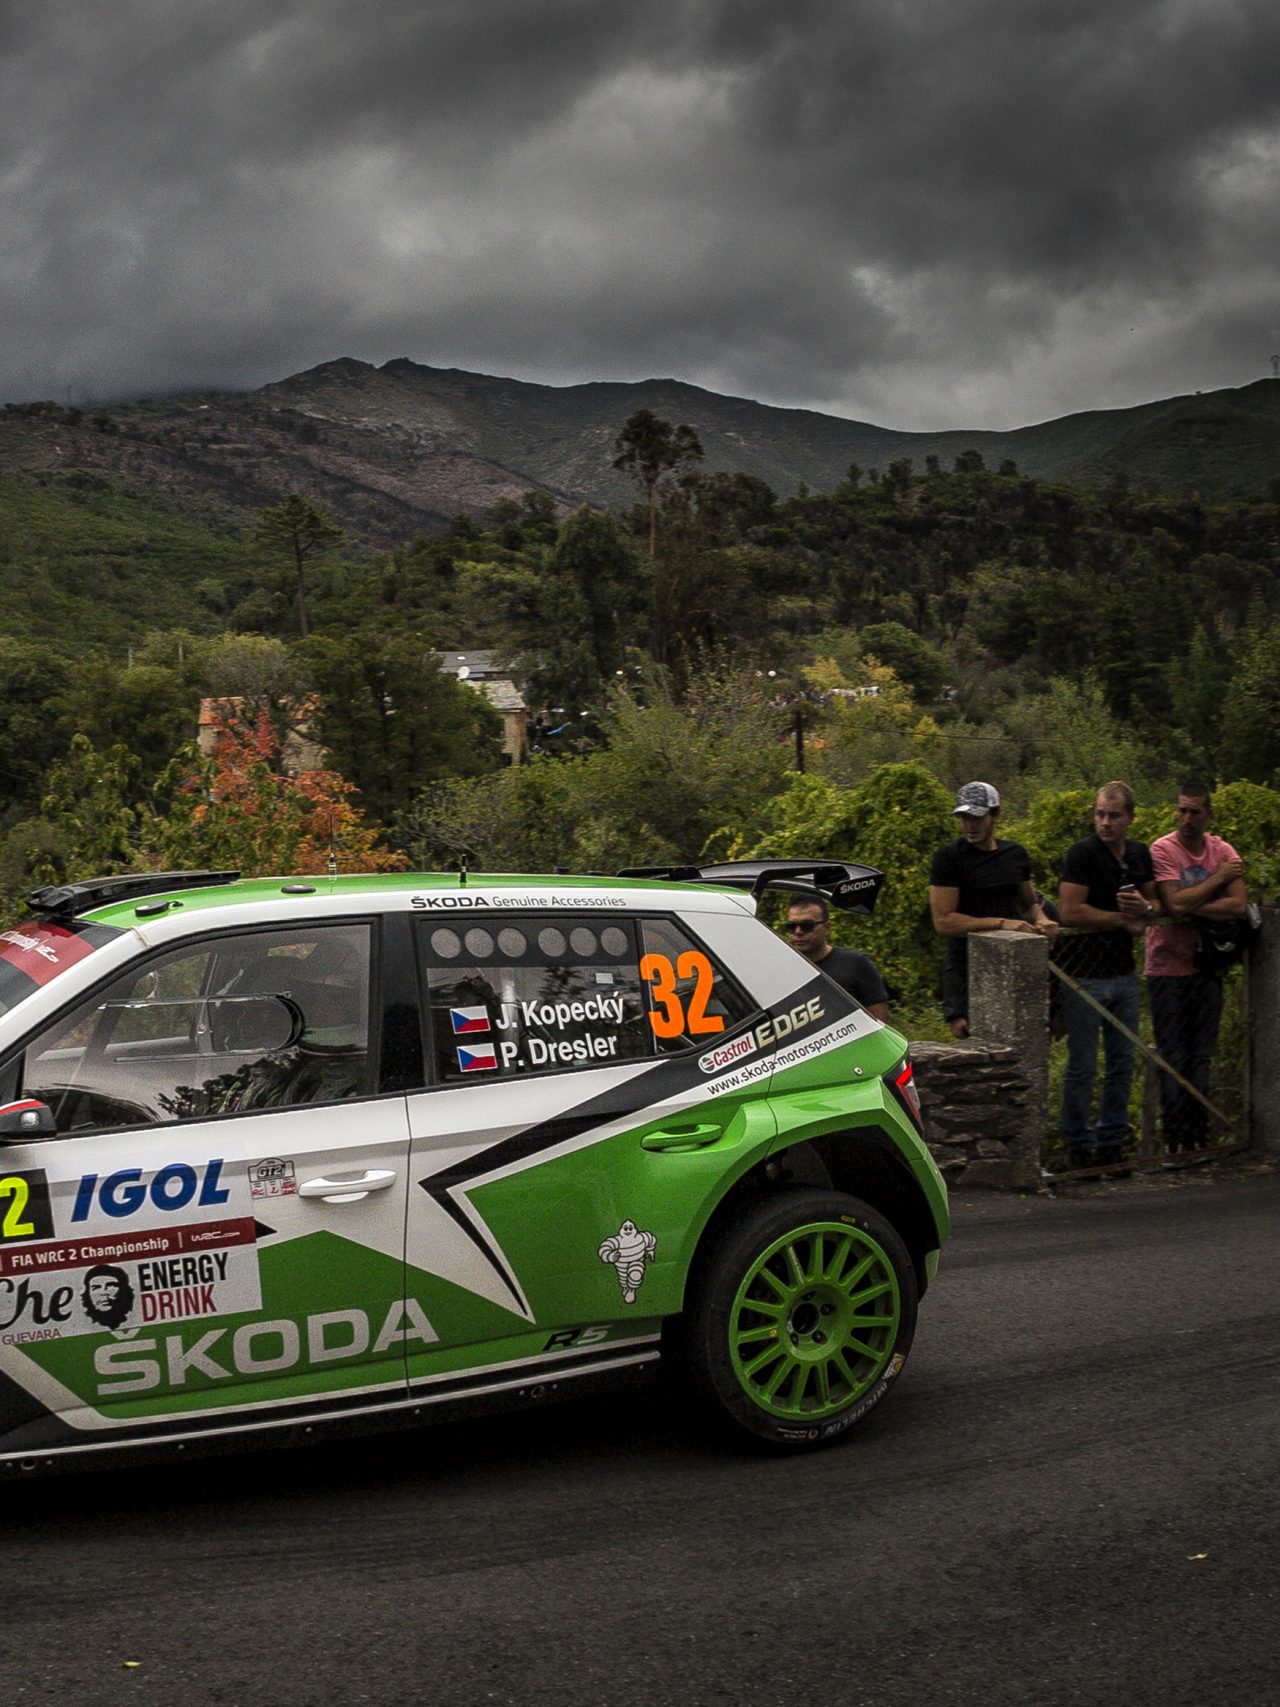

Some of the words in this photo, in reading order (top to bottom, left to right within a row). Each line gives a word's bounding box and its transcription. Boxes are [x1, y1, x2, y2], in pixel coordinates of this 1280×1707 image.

[411, 896, 490, 909] ŠKODA
[492, 896, 548, 907] Genuine
[551, 895, 627, 907] Accessories
[495, 1003, 518, 1030] J.
[521, 991, 625, 1030] Kopecký
[639, 950, 726, 1039] 32
[500, 1041, 525, 1068] P.
[528, 1033, 618, 1065] Dresler
[713, 1036, 754, 1067] Castrol
[754, 995, 826, 1049] EDGE
[707, 1020, 858, 1096] www.skoda-motorsport.com
[70, 1158, 231, 1223] IGOL
[11, 1254, 34, 1268] FIA
[36, 1250, 65, 1265] WRC
[69, 1248, 78, 1260] 2
[81, 1237, 170, 1260] Championship
[137, 1252, 229, 1293] ENERGY
[140, 1284, 218, 1323] DRINK
[2, 1328, 62, 1346] GUEVARA
[94, 1298, 440, 1396] ŠKODA
